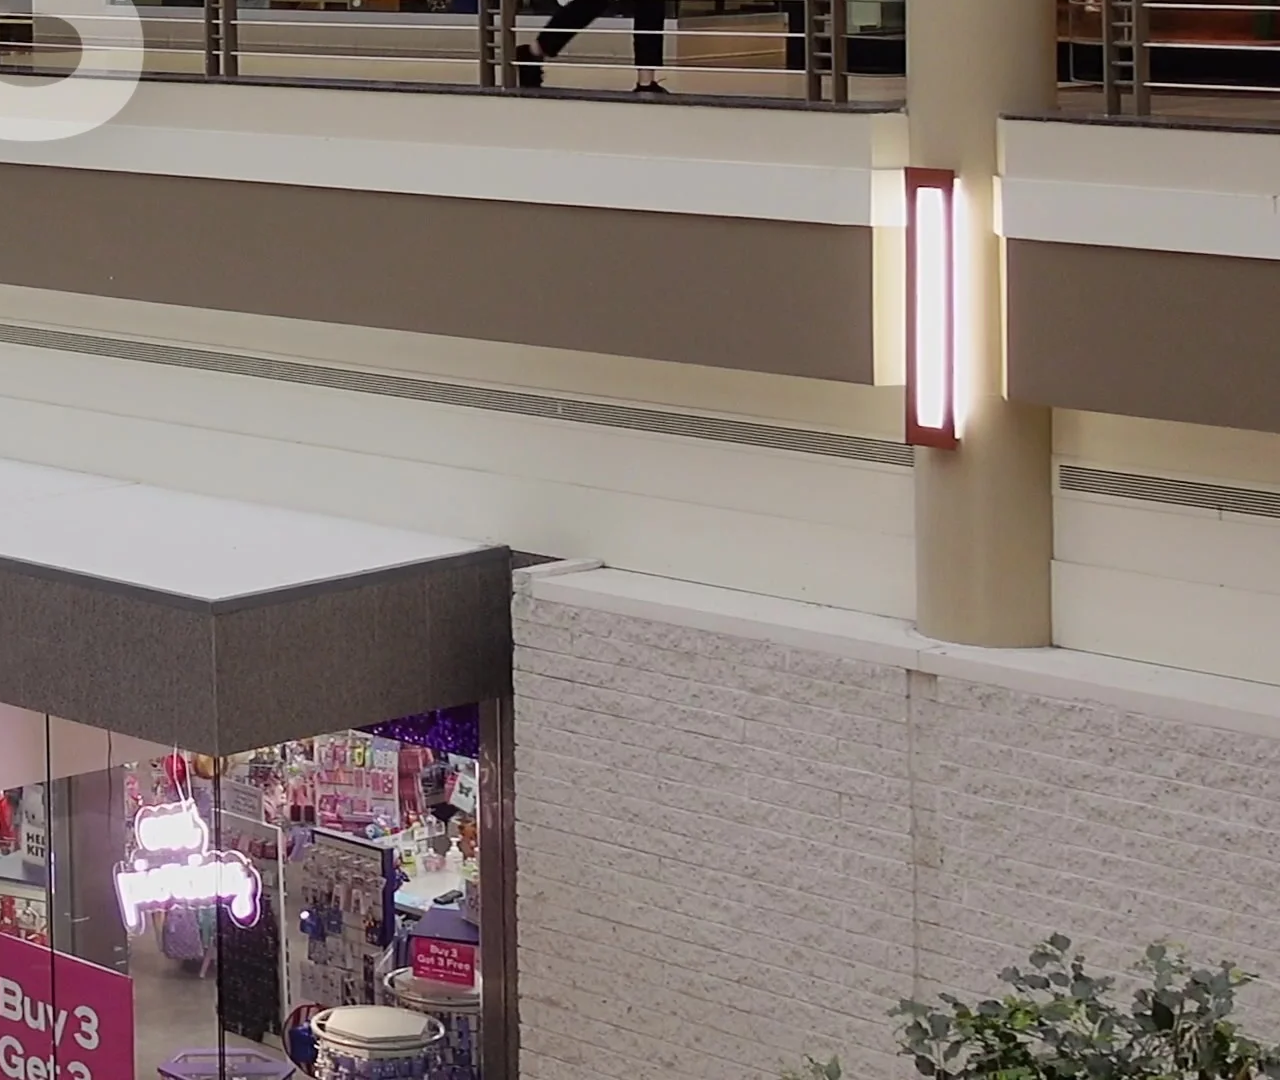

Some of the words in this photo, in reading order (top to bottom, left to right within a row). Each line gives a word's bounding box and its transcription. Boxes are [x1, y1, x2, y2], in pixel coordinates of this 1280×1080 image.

[430, 944, 449, 958] Buy
[450, 948, 458, 958] 3
[416, 954, 435, 965] Get
[446, 958, 471, 971] Free
[73, 1005, 100, 1051] 3
